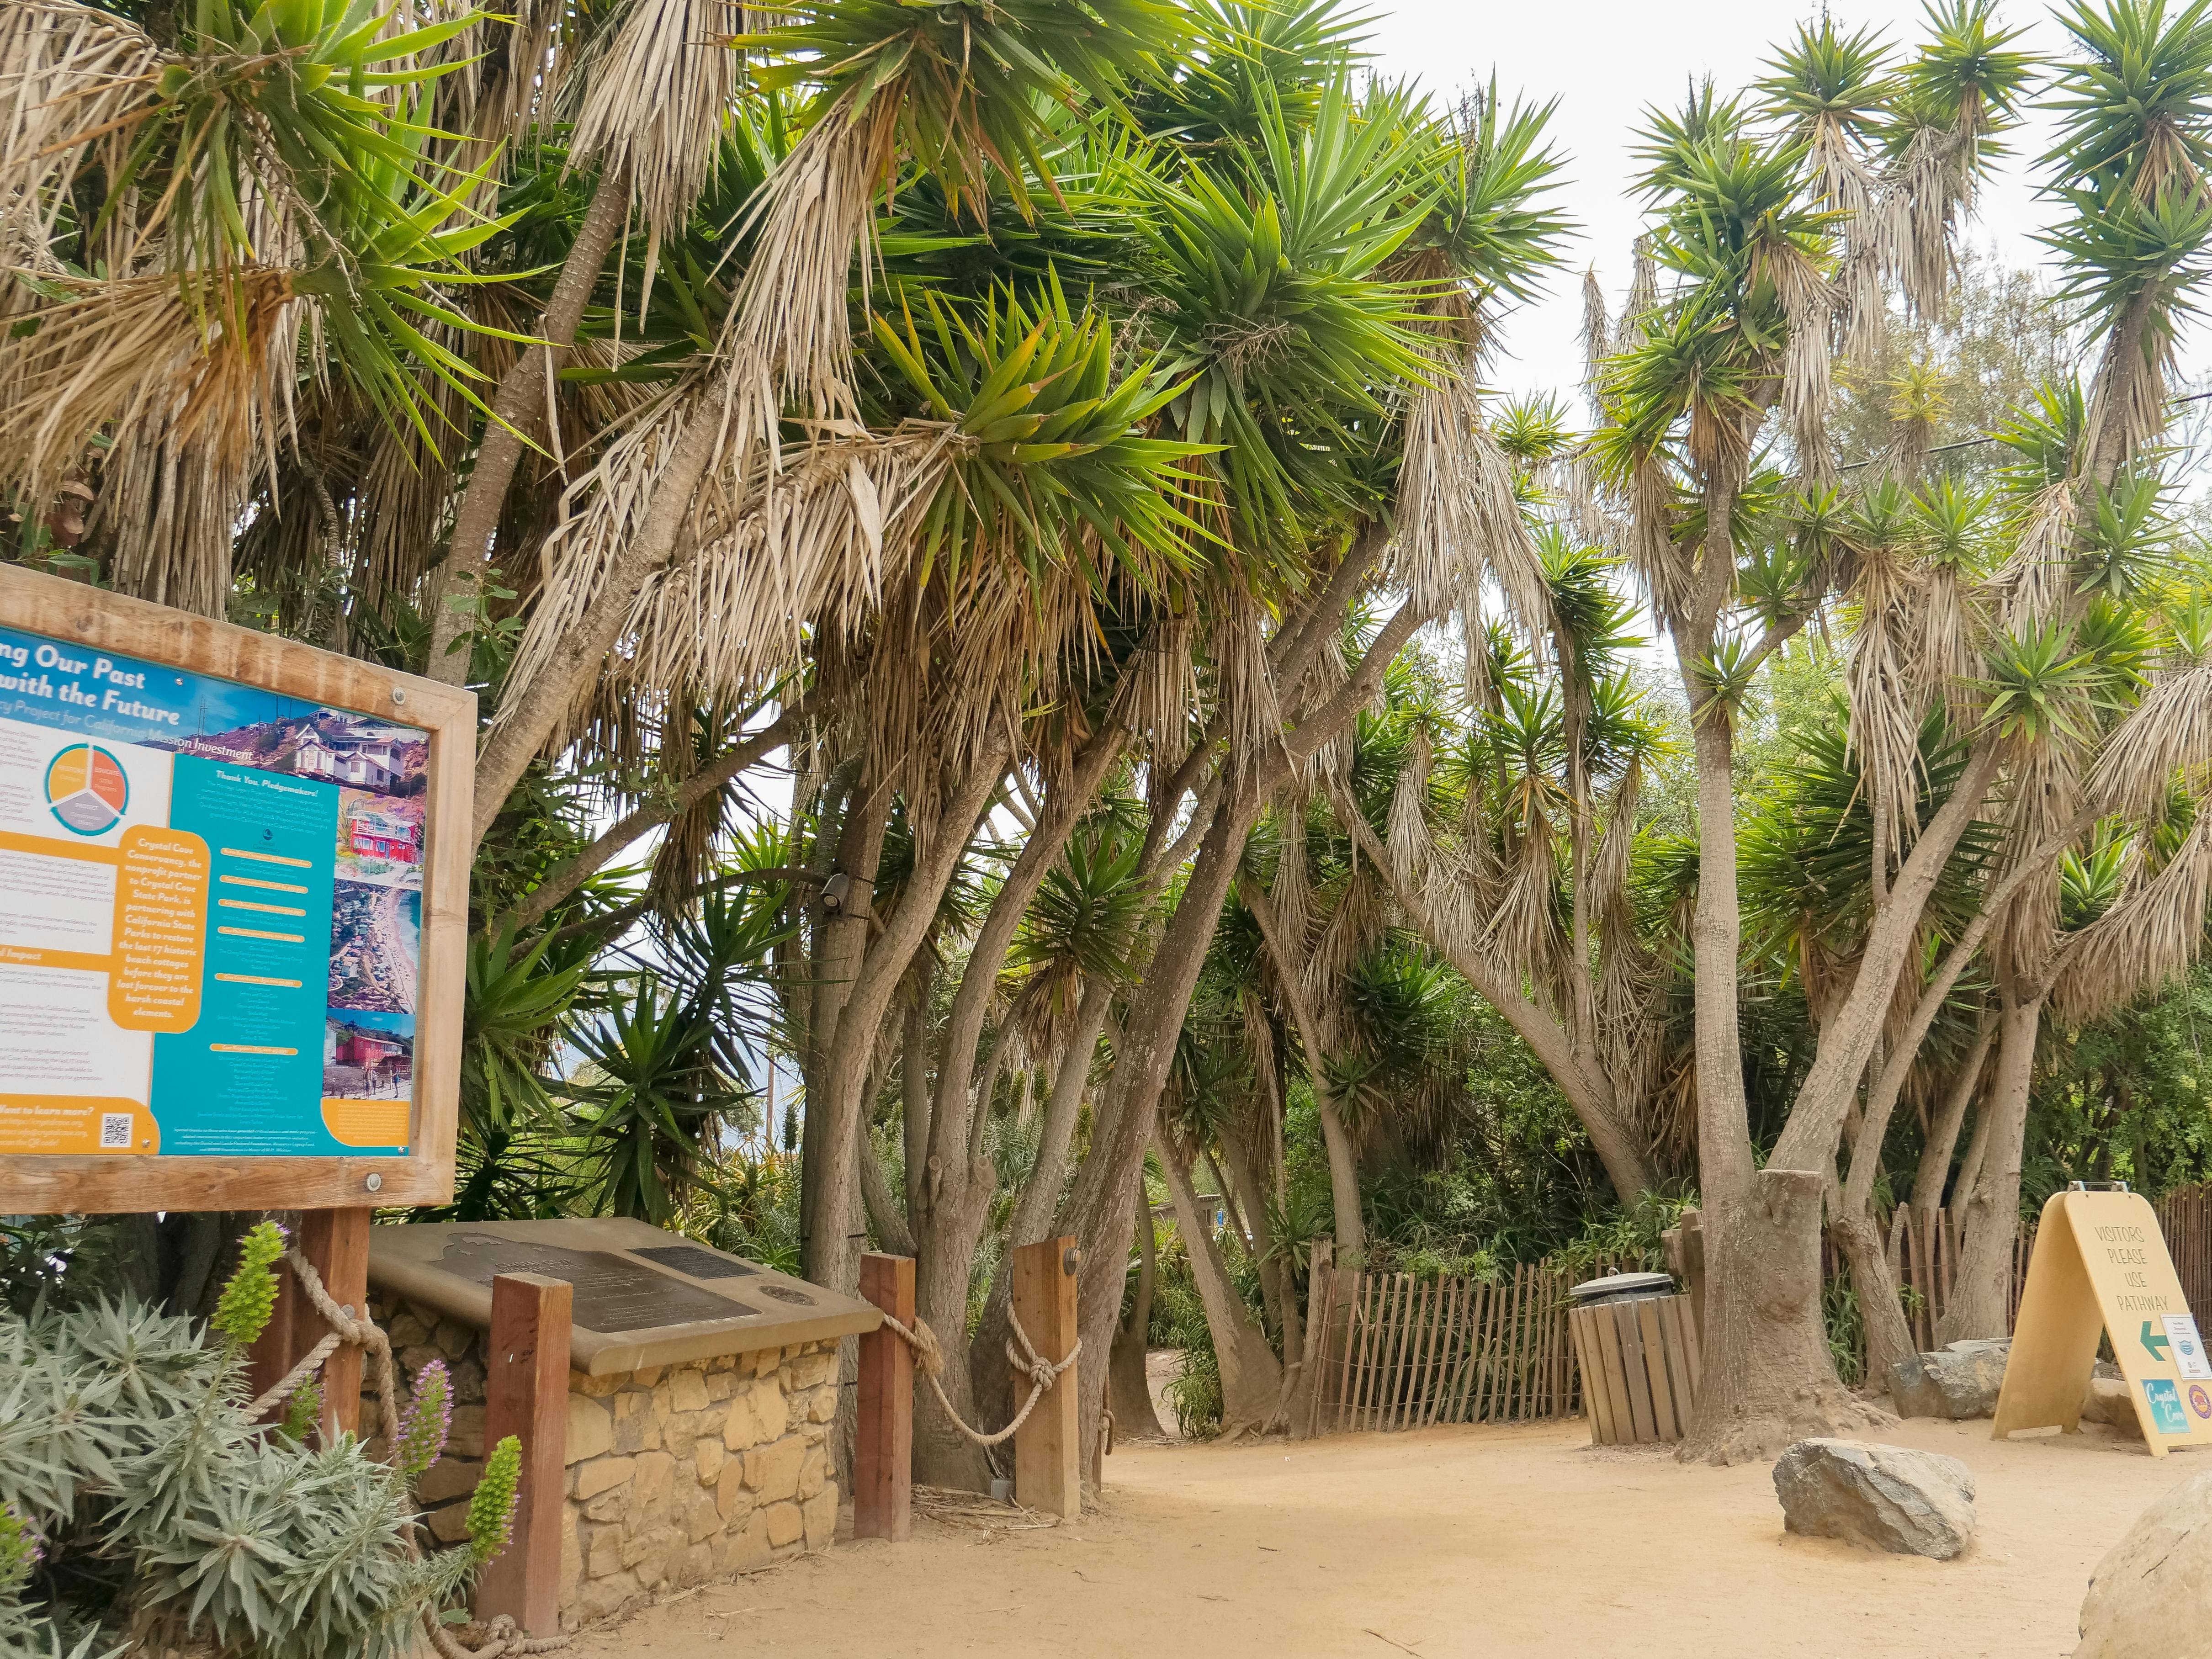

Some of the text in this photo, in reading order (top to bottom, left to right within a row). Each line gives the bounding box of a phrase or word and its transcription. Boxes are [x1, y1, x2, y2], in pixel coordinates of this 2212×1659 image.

[36, 645, 88, 674] Our
[93, 658, 146, 689] Past
[0, 672, 180, 725] with the Future
[15, 700, 59, 720] Project
[61, 710, 81, 726] for
[85, 715, 145, 738] California
[149, 729, 192, 748] Mission
[194, 739, 253, 761] Investment
[95, 767, 120, 776] EDUCATE
[216, 770, 241, 782] Thank
[261, 779, 318, 797] Pledgemakers!
[138, 837, 193, 853] Crystal Cove
[127, 849, 202, 868] Conservancy, the
[125, 865, 202, 880] nonprofit partner
[129, 875, 196, 892] to Crystal Cove
[133, 889, 191, 904] State Park, is
[125, 903, 195, 917] partnering with
[124, 914, 195, 930] California State
[124, 927, 194, 943] Parks to restore
[6, 948, 42, 960] Impact
[119, 940, 197, 956] the last 17 historic
[125, 954, 188, 969] beach cottages
[123, 966, 152, 978] before
[154, 969, 172, 981] they
[117, 979, 193, 993] lost forever to the
[125, 993, 185, 1005] harsh coastal
[133, 1007, 174, 1018] elements.
[23, 1105, 32, 1114] to
[35, 1105, 60, 1114] learn
[63, 1107, 94, 1115] more?
[2094, 1226, 2144, 1242] VISITORS
[2106, 1248, 2148, 1264] PLEASE
[2124, 1271, 2148, 1288] USE
[2116, 1295, 2169, 1311] PATHWAY
[2147, 1383, 2177, 1408] Crystal
[2164, 1403, 2186, 1422] Cove
